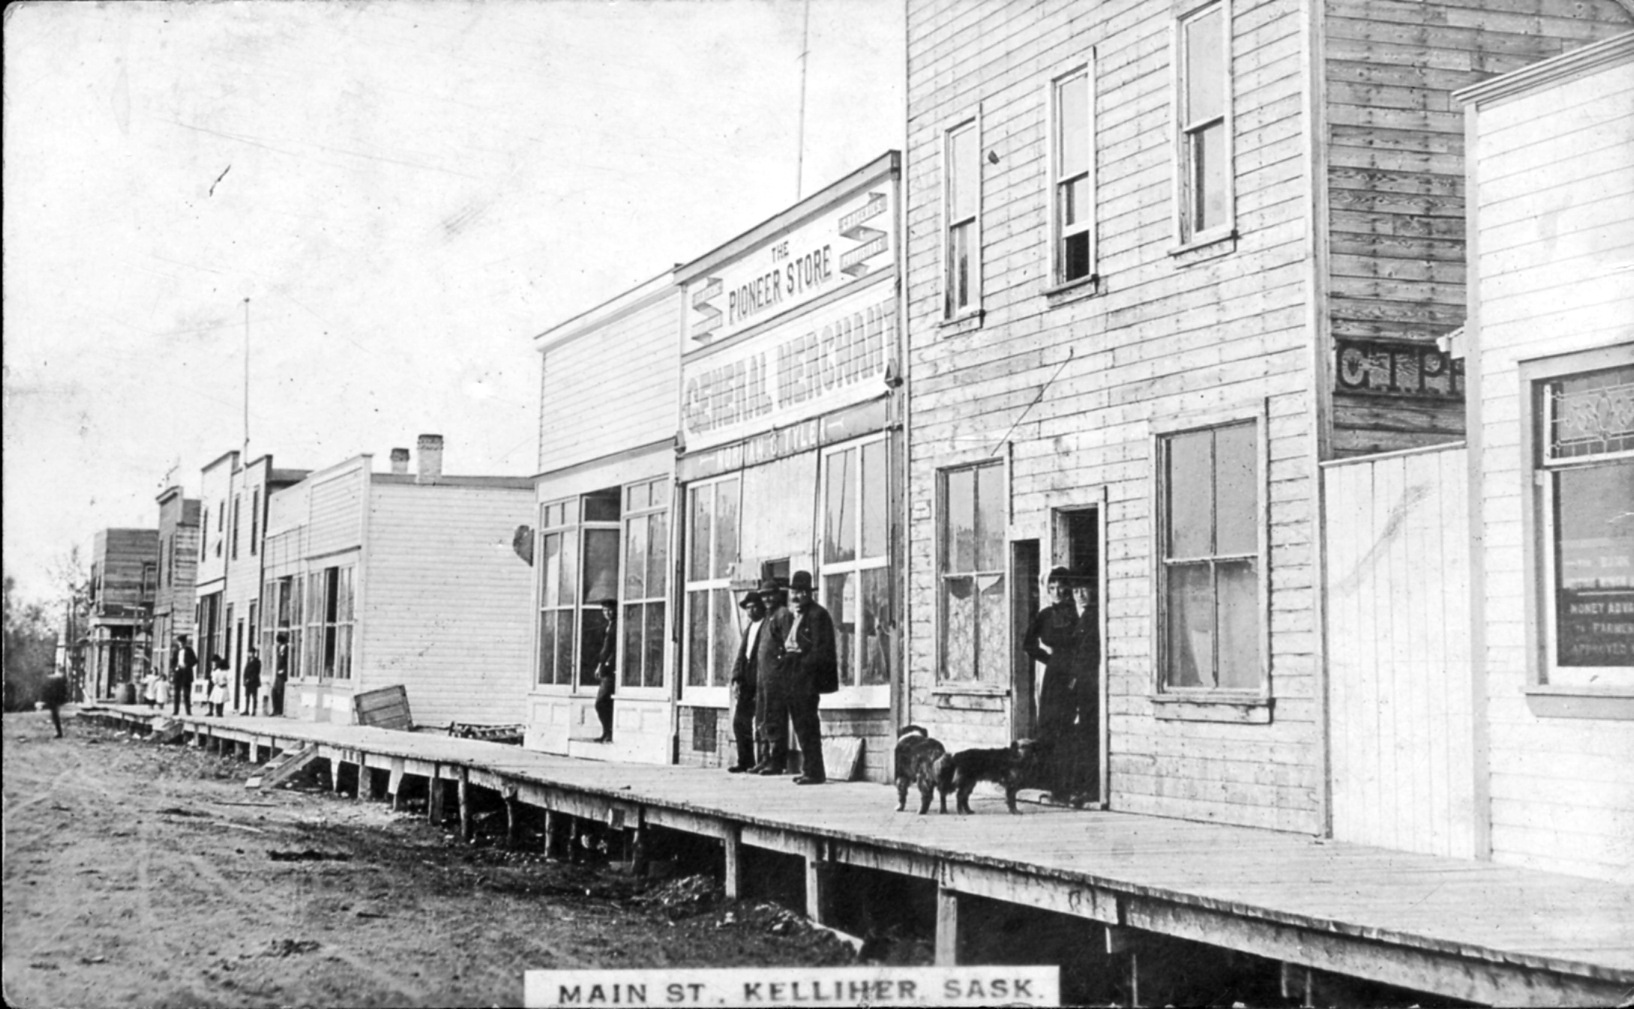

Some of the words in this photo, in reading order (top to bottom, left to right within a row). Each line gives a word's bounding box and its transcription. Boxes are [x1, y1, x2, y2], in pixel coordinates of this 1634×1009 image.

[771, 240, 790, 263] THE
[728, 268, 783, 326] PIONEER
[786, 244, 832, 296] STORE
[685, 351, 773, 434] GENERAL
[1570, 602, 1605, 615] MONEY
